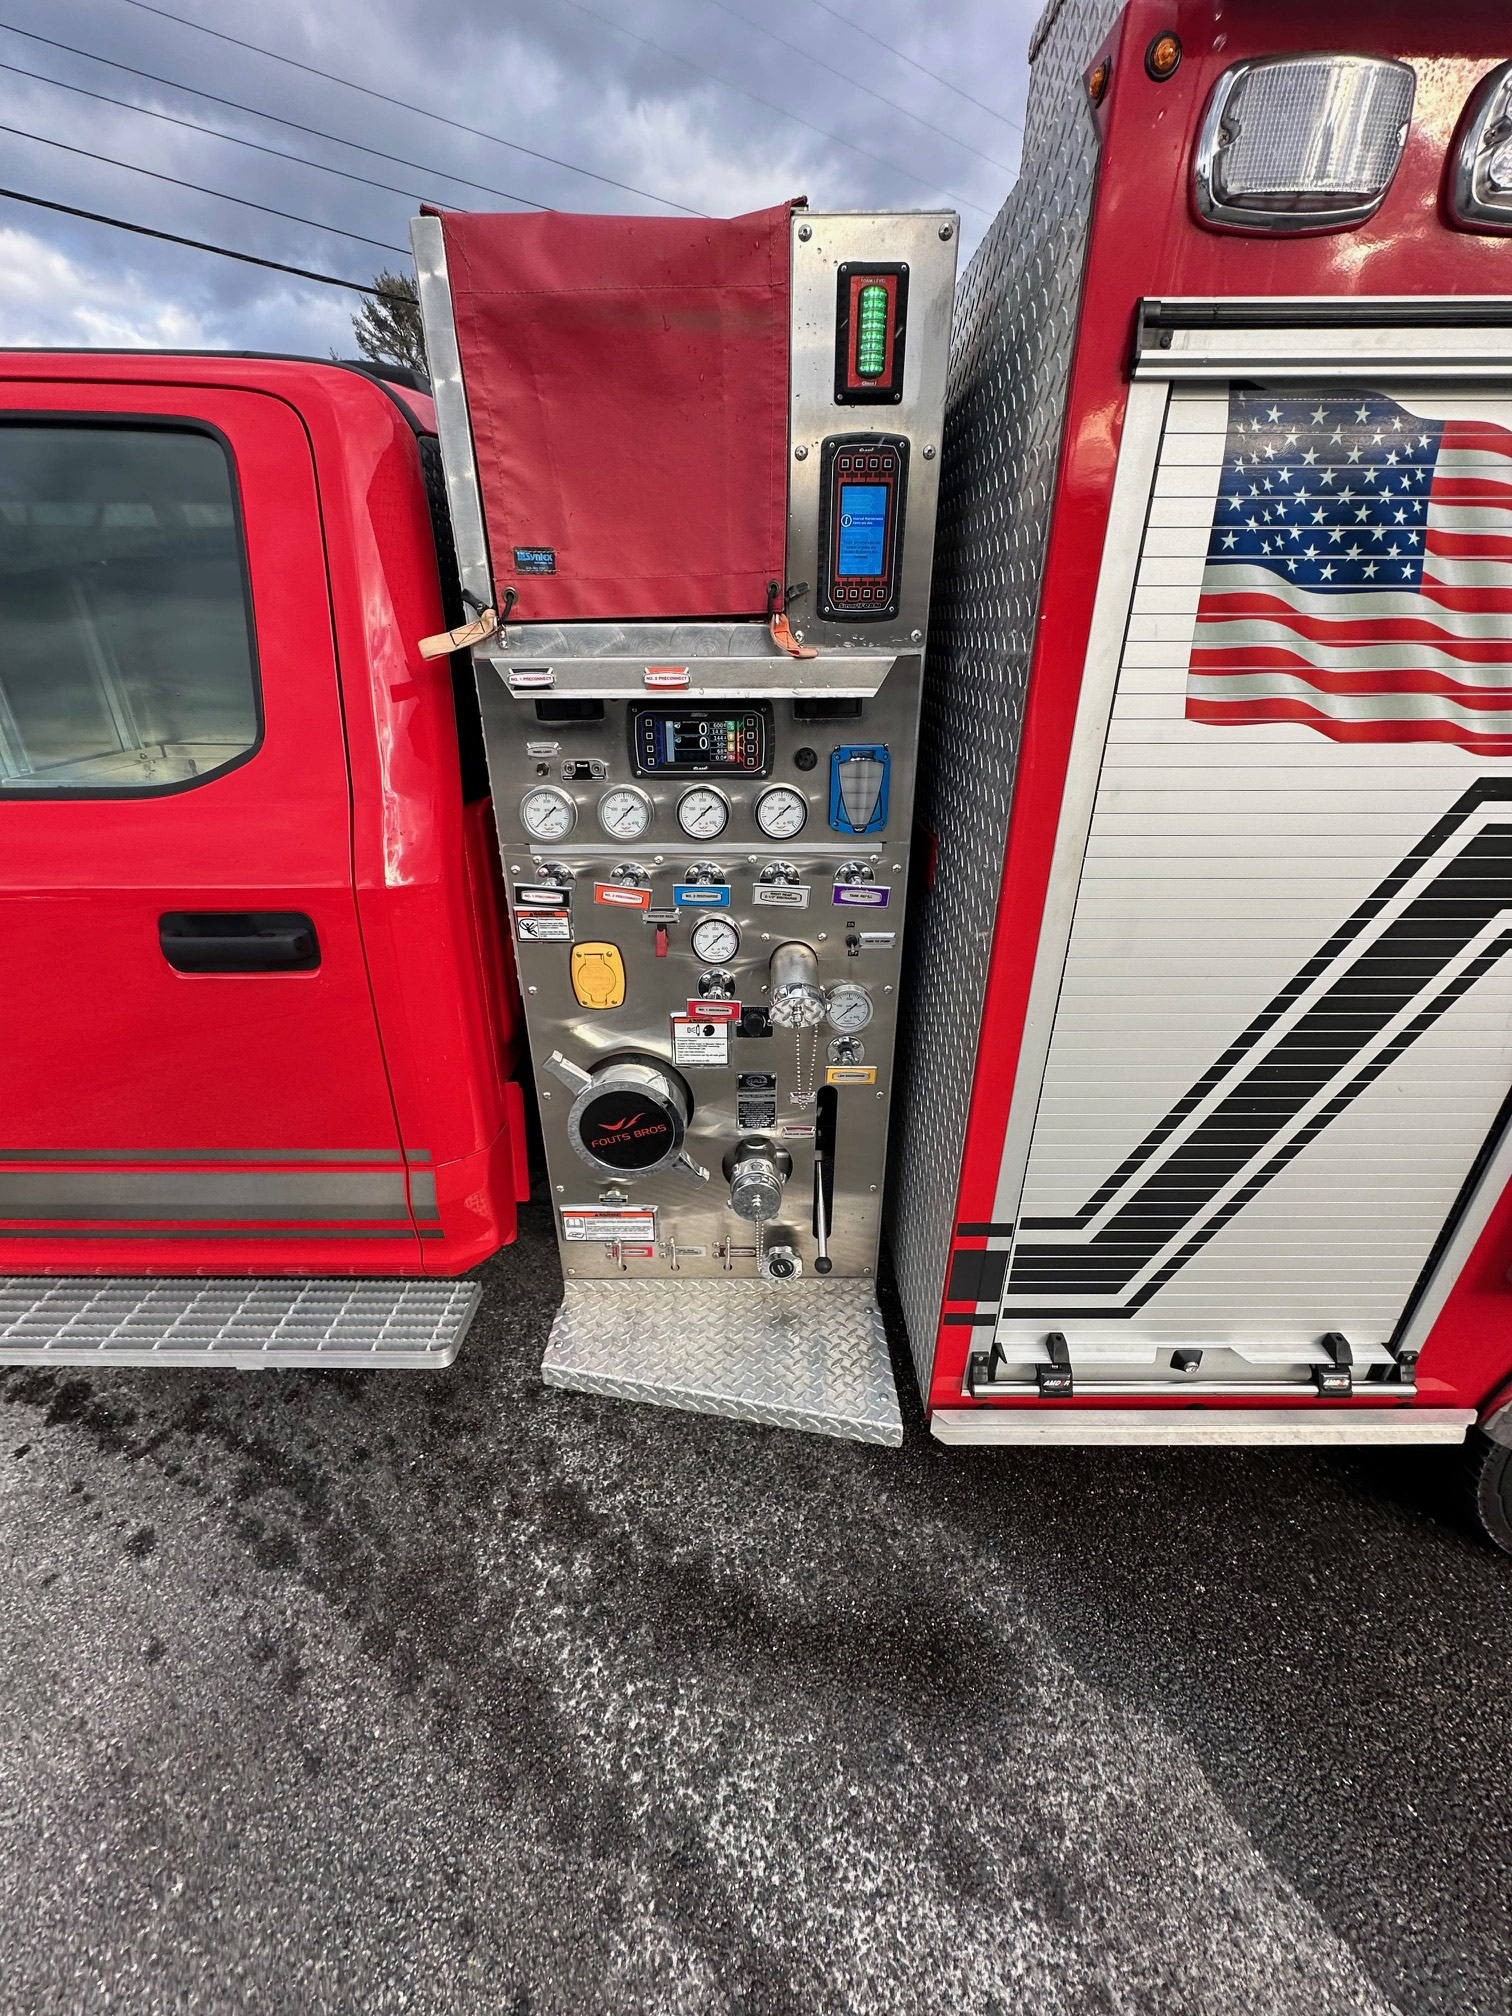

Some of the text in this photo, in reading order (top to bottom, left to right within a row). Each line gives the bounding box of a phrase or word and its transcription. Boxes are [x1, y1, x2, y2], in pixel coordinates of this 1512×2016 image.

[699, 722, 708, 735] 0
[699, 737, 708, 750] 0
[591, 1124, 667, 1148] FOUTS BROS
